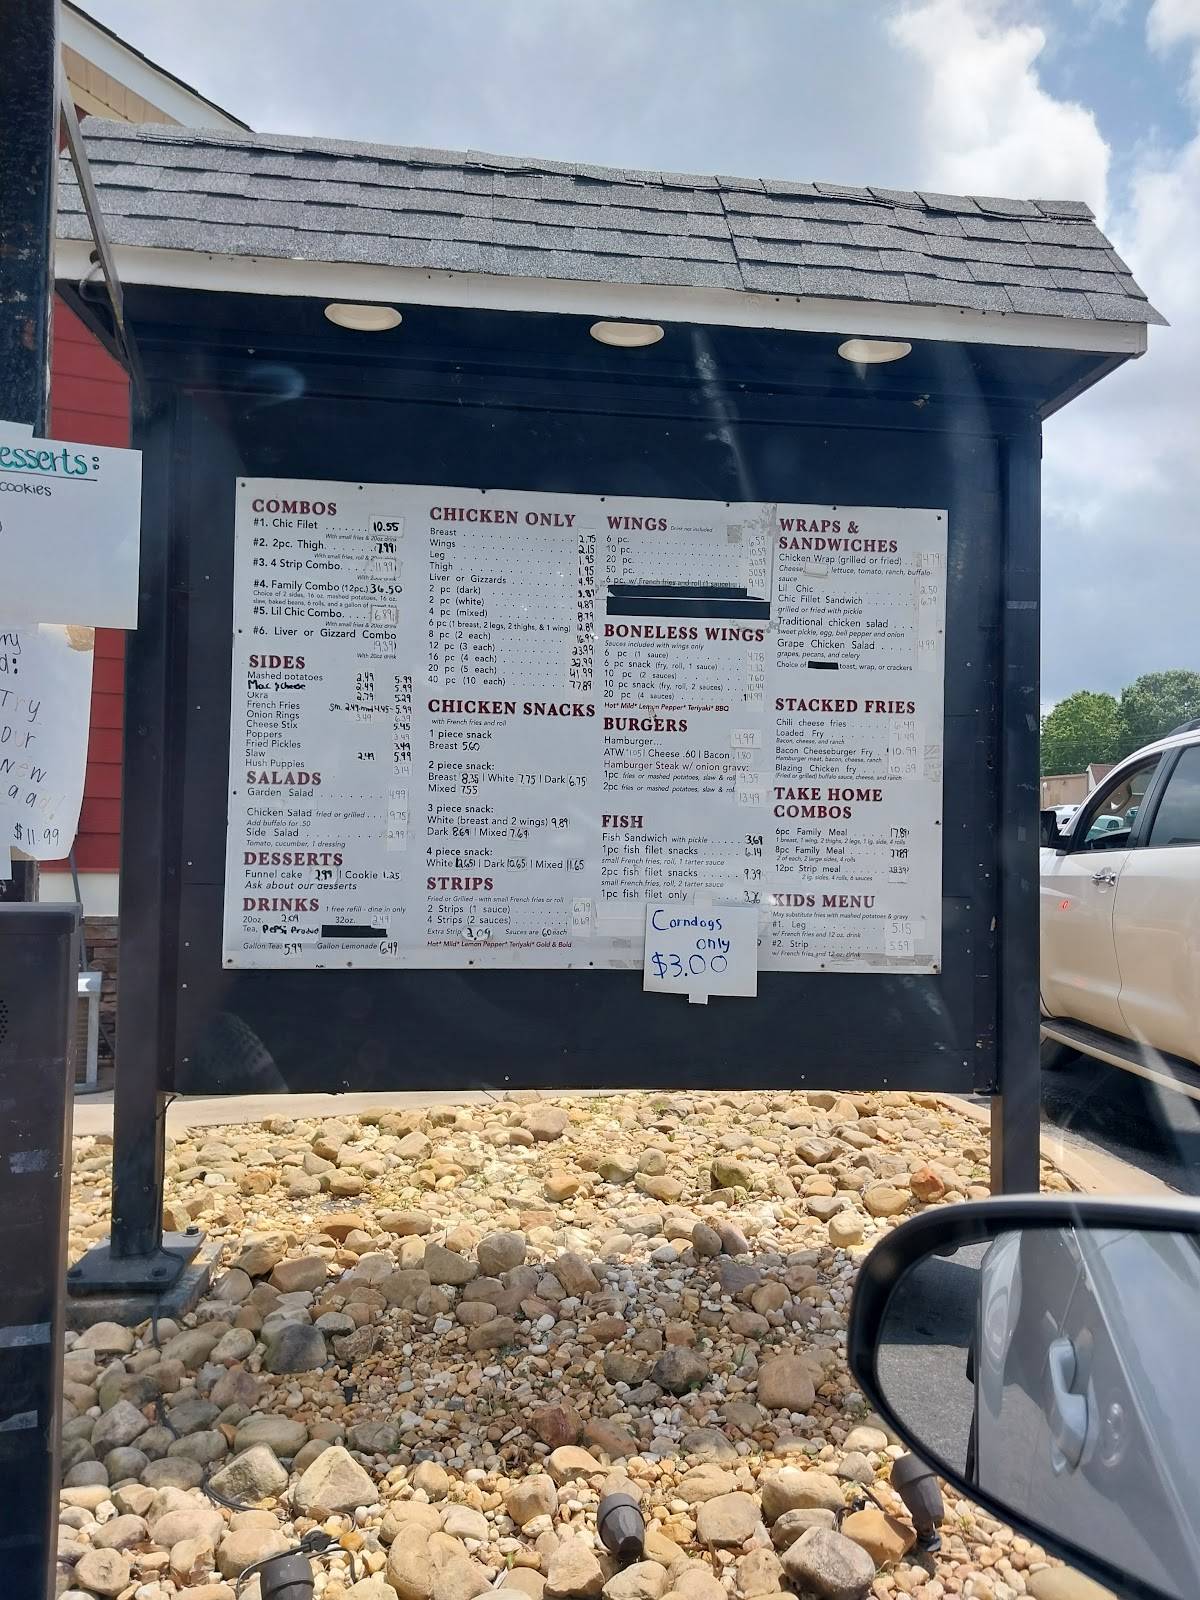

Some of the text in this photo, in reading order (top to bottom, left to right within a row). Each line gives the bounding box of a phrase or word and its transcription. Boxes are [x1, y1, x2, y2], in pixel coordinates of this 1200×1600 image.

[252, 499, 337, 515] COMBOS
[430, 507, 575, 527] CHICKEN ONLY
[253, 518, 399, 532] #1. Chic Filet 10.55
[607, 516, 667, 531] WINGS
[779, 518, 859, 534] WRAPS &
[430, 528, 456, 536] Breast
[253, 539, 268, 547] #2.
[272, 539, 293, 548] 2pc.
[430, 539, 455, 548] Wings
[779, 537, 898, 553] SANDWICHES
[430, 551, 445, 560] Leg
[779, 554, 810, 562] Chicken
[814, 555, 834, 564] Wrap
[838, 555, 866, 565] (grilled
[880, 556, 901, 565] fried)
[253, 558, 267, 566] #3.
[280, 559, 303, 570] Strip
[430, 562, 452, 571] Thigh
[430, 573, 450, 581] Liver
[471, 575, 506, 583] Gizzards
[254, 580, 268, 588] #4.
[271, 581, 302, 592] Family
[305, 582, 339, 592] Combo
[440, 586, 450, 594] pc
[457, 586, 480, 594] (dark)
[778, 595, 863, 604] Chic Fillet Sandwich
[253, 606, 268, 614] #5.
[271, 607, 282, 615] Lil
[284, 607, 304, 616] Chic
[778, 617, 888, 628] Traditional chicken salad
[253, 626, 267, 635] #6.
[274, 627, 297, 636] Liver
[320, 629, 356, 638] Gizzard
[363, 630, 396, 639] Combo
[604, 624, 764, 641] BONELESS WINGS
[249, 655, 305, 669] SIDES
[247, 671, 281, 680] Mashed
[285, 672, 323, 681] potatoes
[247, 701, 275, 709] French
[428, 699, 595, 717] CHICKEN SNACKS
[775, 698, 915, 713] STACKED FRIES
[247, 710, 299, 721] Onion Rings
[247, 720, 278, 728] Cheese
[604, 718, 688, 732] BURGERS
[438, 730, 463, 739] piece
[467, 731, 492, 739] snack
[812, 730, 824, 738] Fry
[246, 740, 300, 748] Fried Pickles
[804, 747, 856, 756] Cheeseburger
[861, 749, 872, 757] Fry
[271, 760, 304, 768] Puppies
[604, 761, 652, 771] Hamburger
[682, 762, 693, 770] w/
[246, 771, 321, 785] SALADS
[428, 773, 565, 783] Breast White Dark
[248, 788, 313, 797] Garden Salad
[774, 787, 882, 801] TAKE HOME
[247, 808, 283, 816] Chicken
[774, 805, 851, 818] COMBOS
[427, 816, 454, 824] White
[458, 817, 488, 825] (breast
[520, 818, 547, 827] wings)
[602, 815, 643, 828] FISH
[14, 823, 59, 845] $11.99
[246, 828, 266, 836] Side
[776, 828, 789, 837] 6pc
[797, 828, 821, 837] Family
[602, 833, 667, 843] Fish Sandwich
[602, 845, 698, 856] 1pc fish filet snacks
[244, 852, 343, 866] DESSERTS
[245, 870, 277, 878] Funnel
[345, 871, 377, 879] Cookie
[245, 881, 262, 889] Ask
[427, 877, 493, 890] STRIPS
[243, 897, 319, 911] DRINKS
[772, 894, 876, 908] KIDS MENU
[438, 916, 462, 925] Strips
[467, 916, 475, 925] (2
[480, 917, 511, 925] sauces)
[652, 909, 722, 931] Corndogs
[696, 938, 730, 953] only
[652, 952, 727, 979] $3.00
